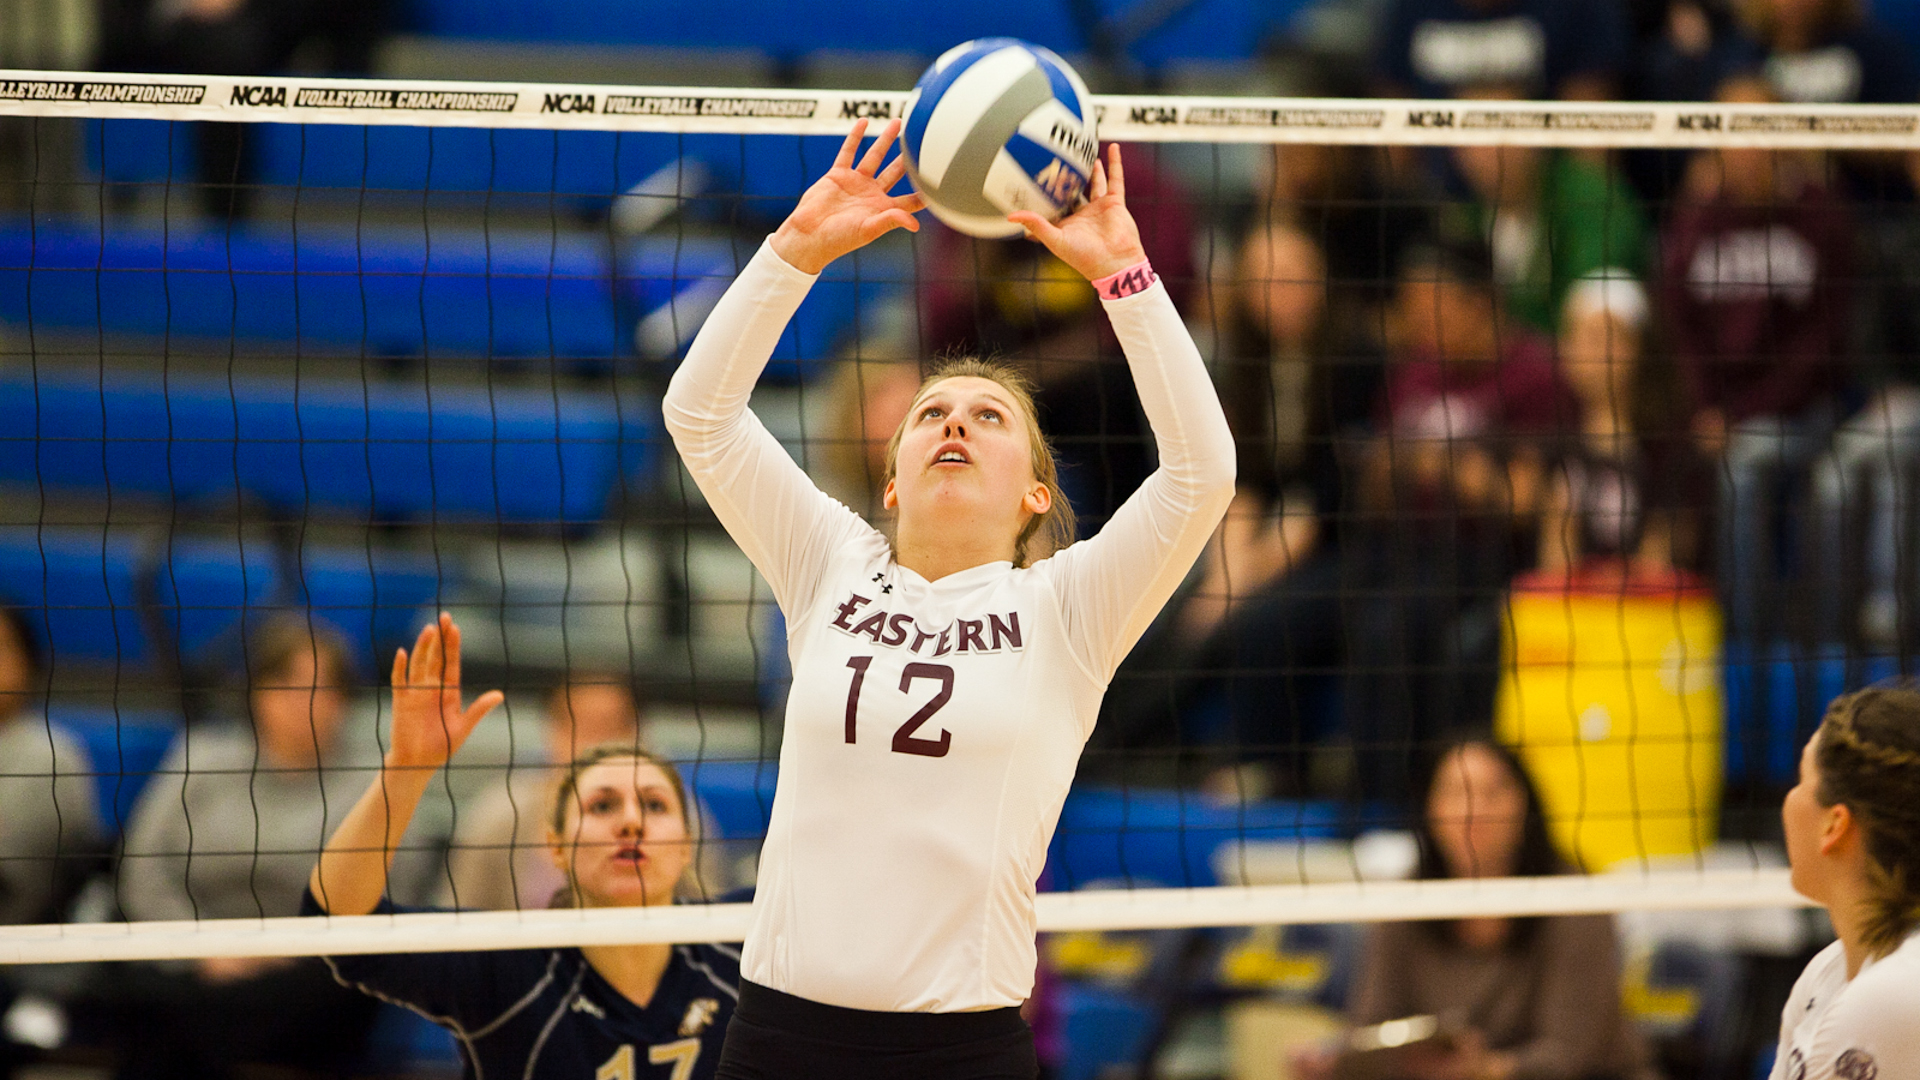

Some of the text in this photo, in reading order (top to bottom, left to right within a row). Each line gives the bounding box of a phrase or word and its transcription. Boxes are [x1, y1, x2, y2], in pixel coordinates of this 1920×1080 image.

[79, 84, 204, 104] CHAMPIONSHIP
[230, 85, 516, 112] NCAA VOLLEYBALL CHAMPIONSHIP
[540, 94, 595, 114] NCAA
[605, 97, 697, 114] VOLLEYBALL
[838, 101, 890, 119] NCAA
[832, 593, 1022, 656] EASTERN
[845, 656, 954, 758] 12
